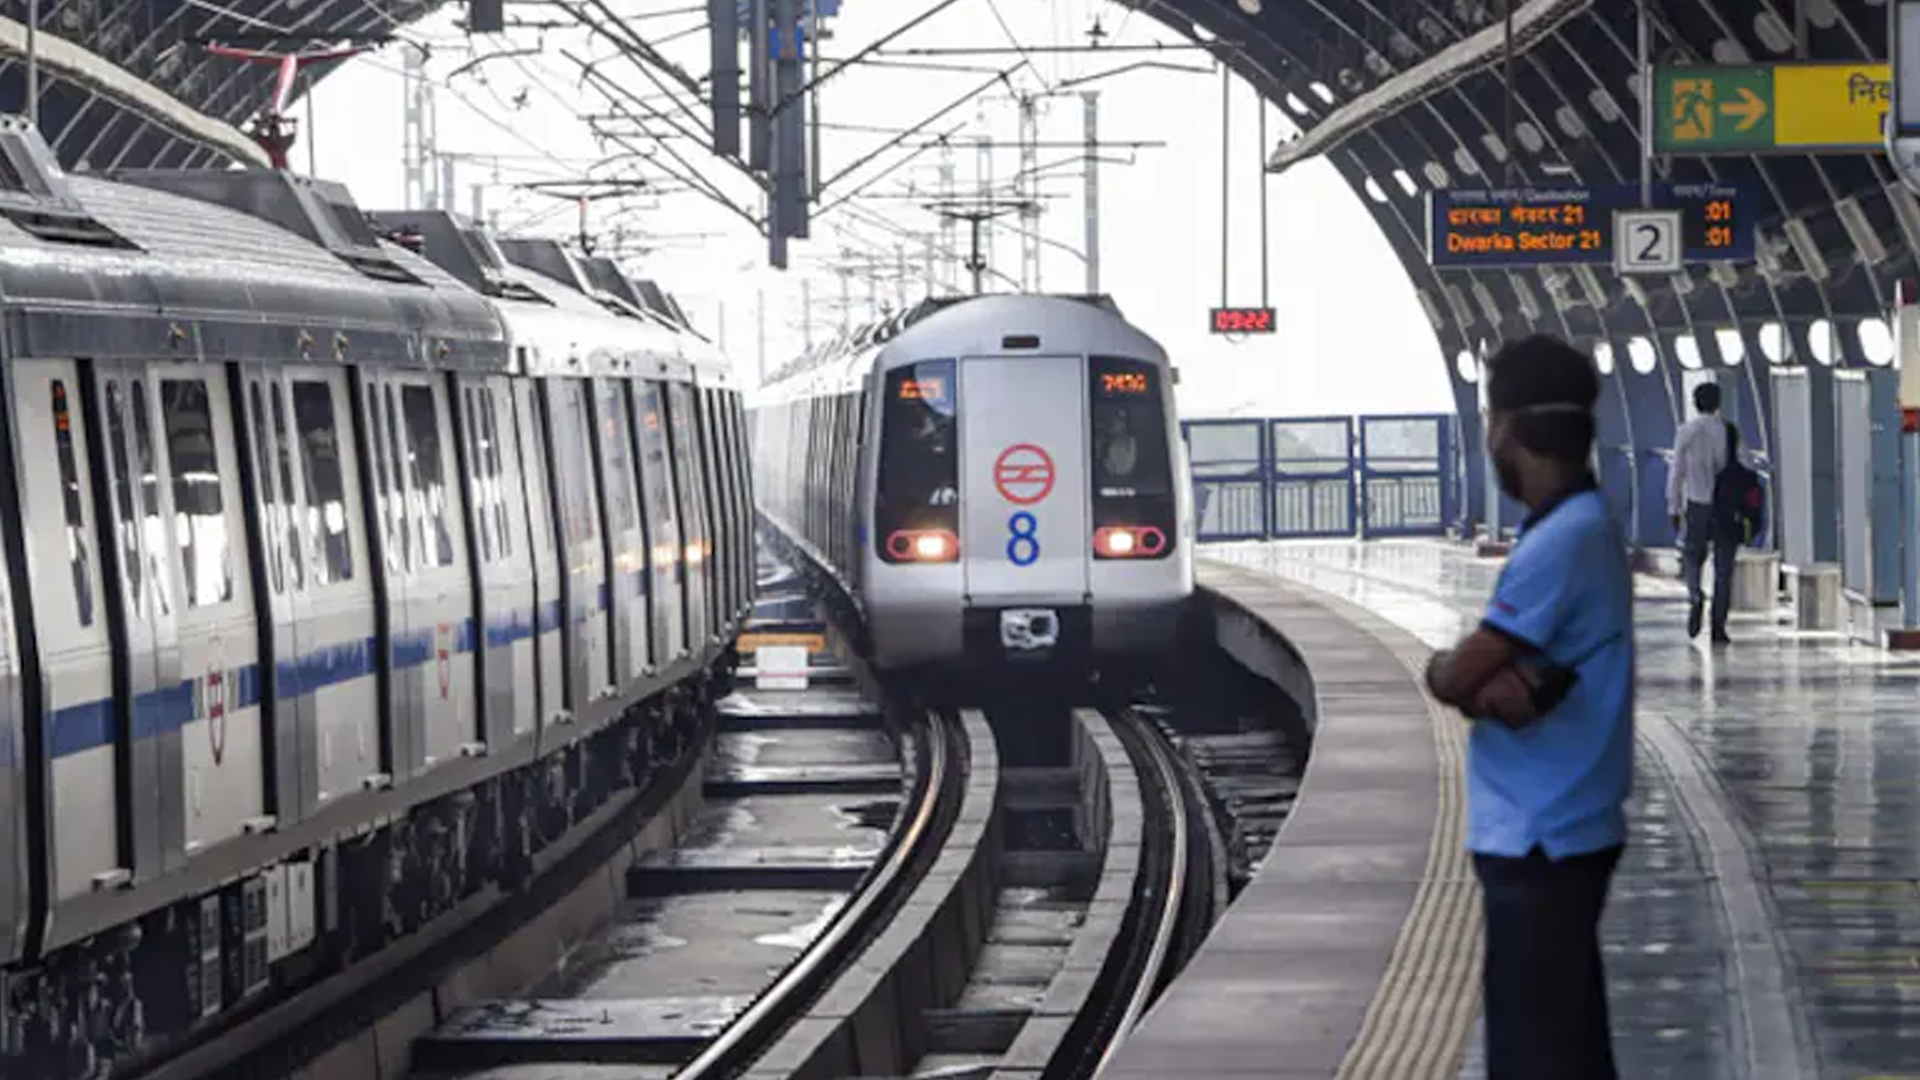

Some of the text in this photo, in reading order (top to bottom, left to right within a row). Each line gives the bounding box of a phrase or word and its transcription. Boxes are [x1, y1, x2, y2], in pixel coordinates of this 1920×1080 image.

[1563, 204, 1584, 225] 21
[1448, 230, 1601, 253] Dwarka Sector 21
[1636, 224, 1662, 260] 2
[1007, 511, 1041, 567] 8
